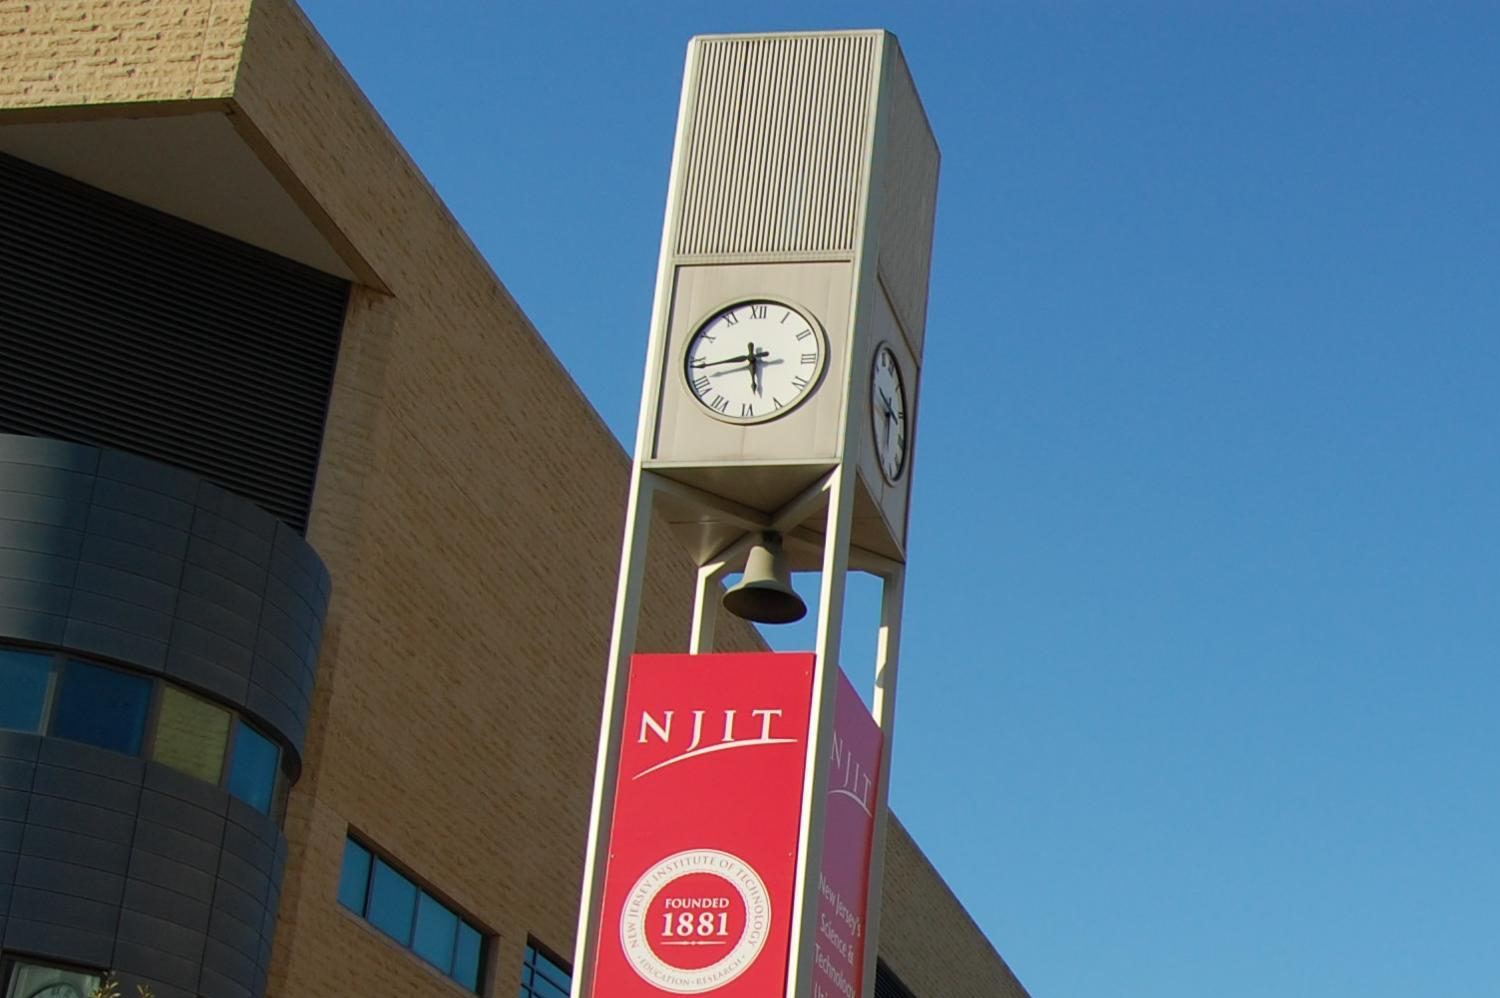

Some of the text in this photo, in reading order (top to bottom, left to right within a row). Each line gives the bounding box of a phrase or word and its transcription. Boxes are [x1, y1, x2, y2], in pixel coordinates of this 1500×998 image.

[637, 709, 783, 751] NJIT
[829, 730, 871, 808] NJIT
[627, 855, 765, 949] NEW JERSEY INSTITUTE OF TECHNOLOGY
[664, 897, 730, 909] FOUNDED
[818, 872, 836, 906] New
[661, 912, 729, 936] 1881
[820, 912, 847, 958] Science
